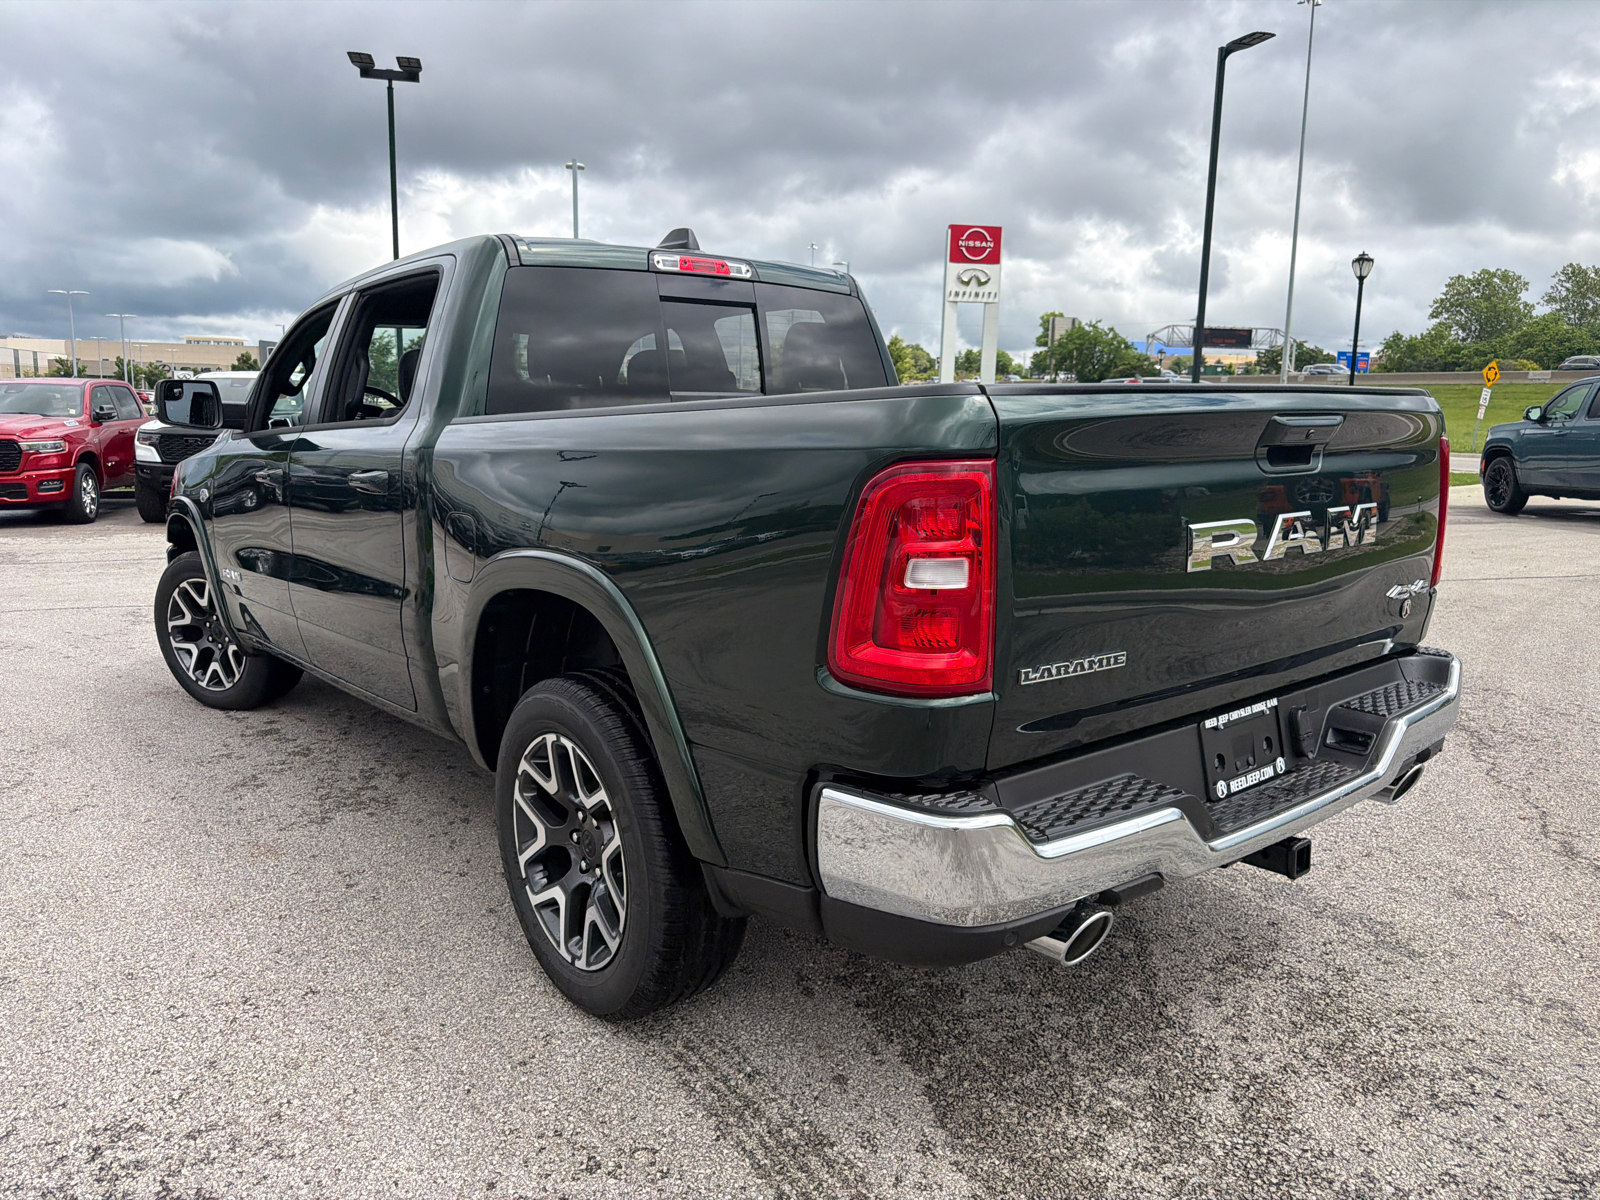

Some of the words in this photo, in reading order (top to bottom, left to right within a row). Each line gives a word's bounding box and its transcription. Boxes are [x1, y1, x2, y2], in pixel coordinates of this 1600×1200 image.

[958, 240, 994, 248] NISSAN
[948, 290, 998, 299] INFINITI
[1187, 503, 1377, 572] RAM
[1020, 651, 1127, 685] LARAMIE
[1204, 717, 1218, 729] REED
[1218, 713, 1229, 724] JEEP
[1229, 706, 1252, 720] CHRYSLER
[1252, 701, 1267, 713] DODGE
[1267, 697, 1278, 708] RAM
[1229, 765, 1275, 793] REEDJEEP.COM
